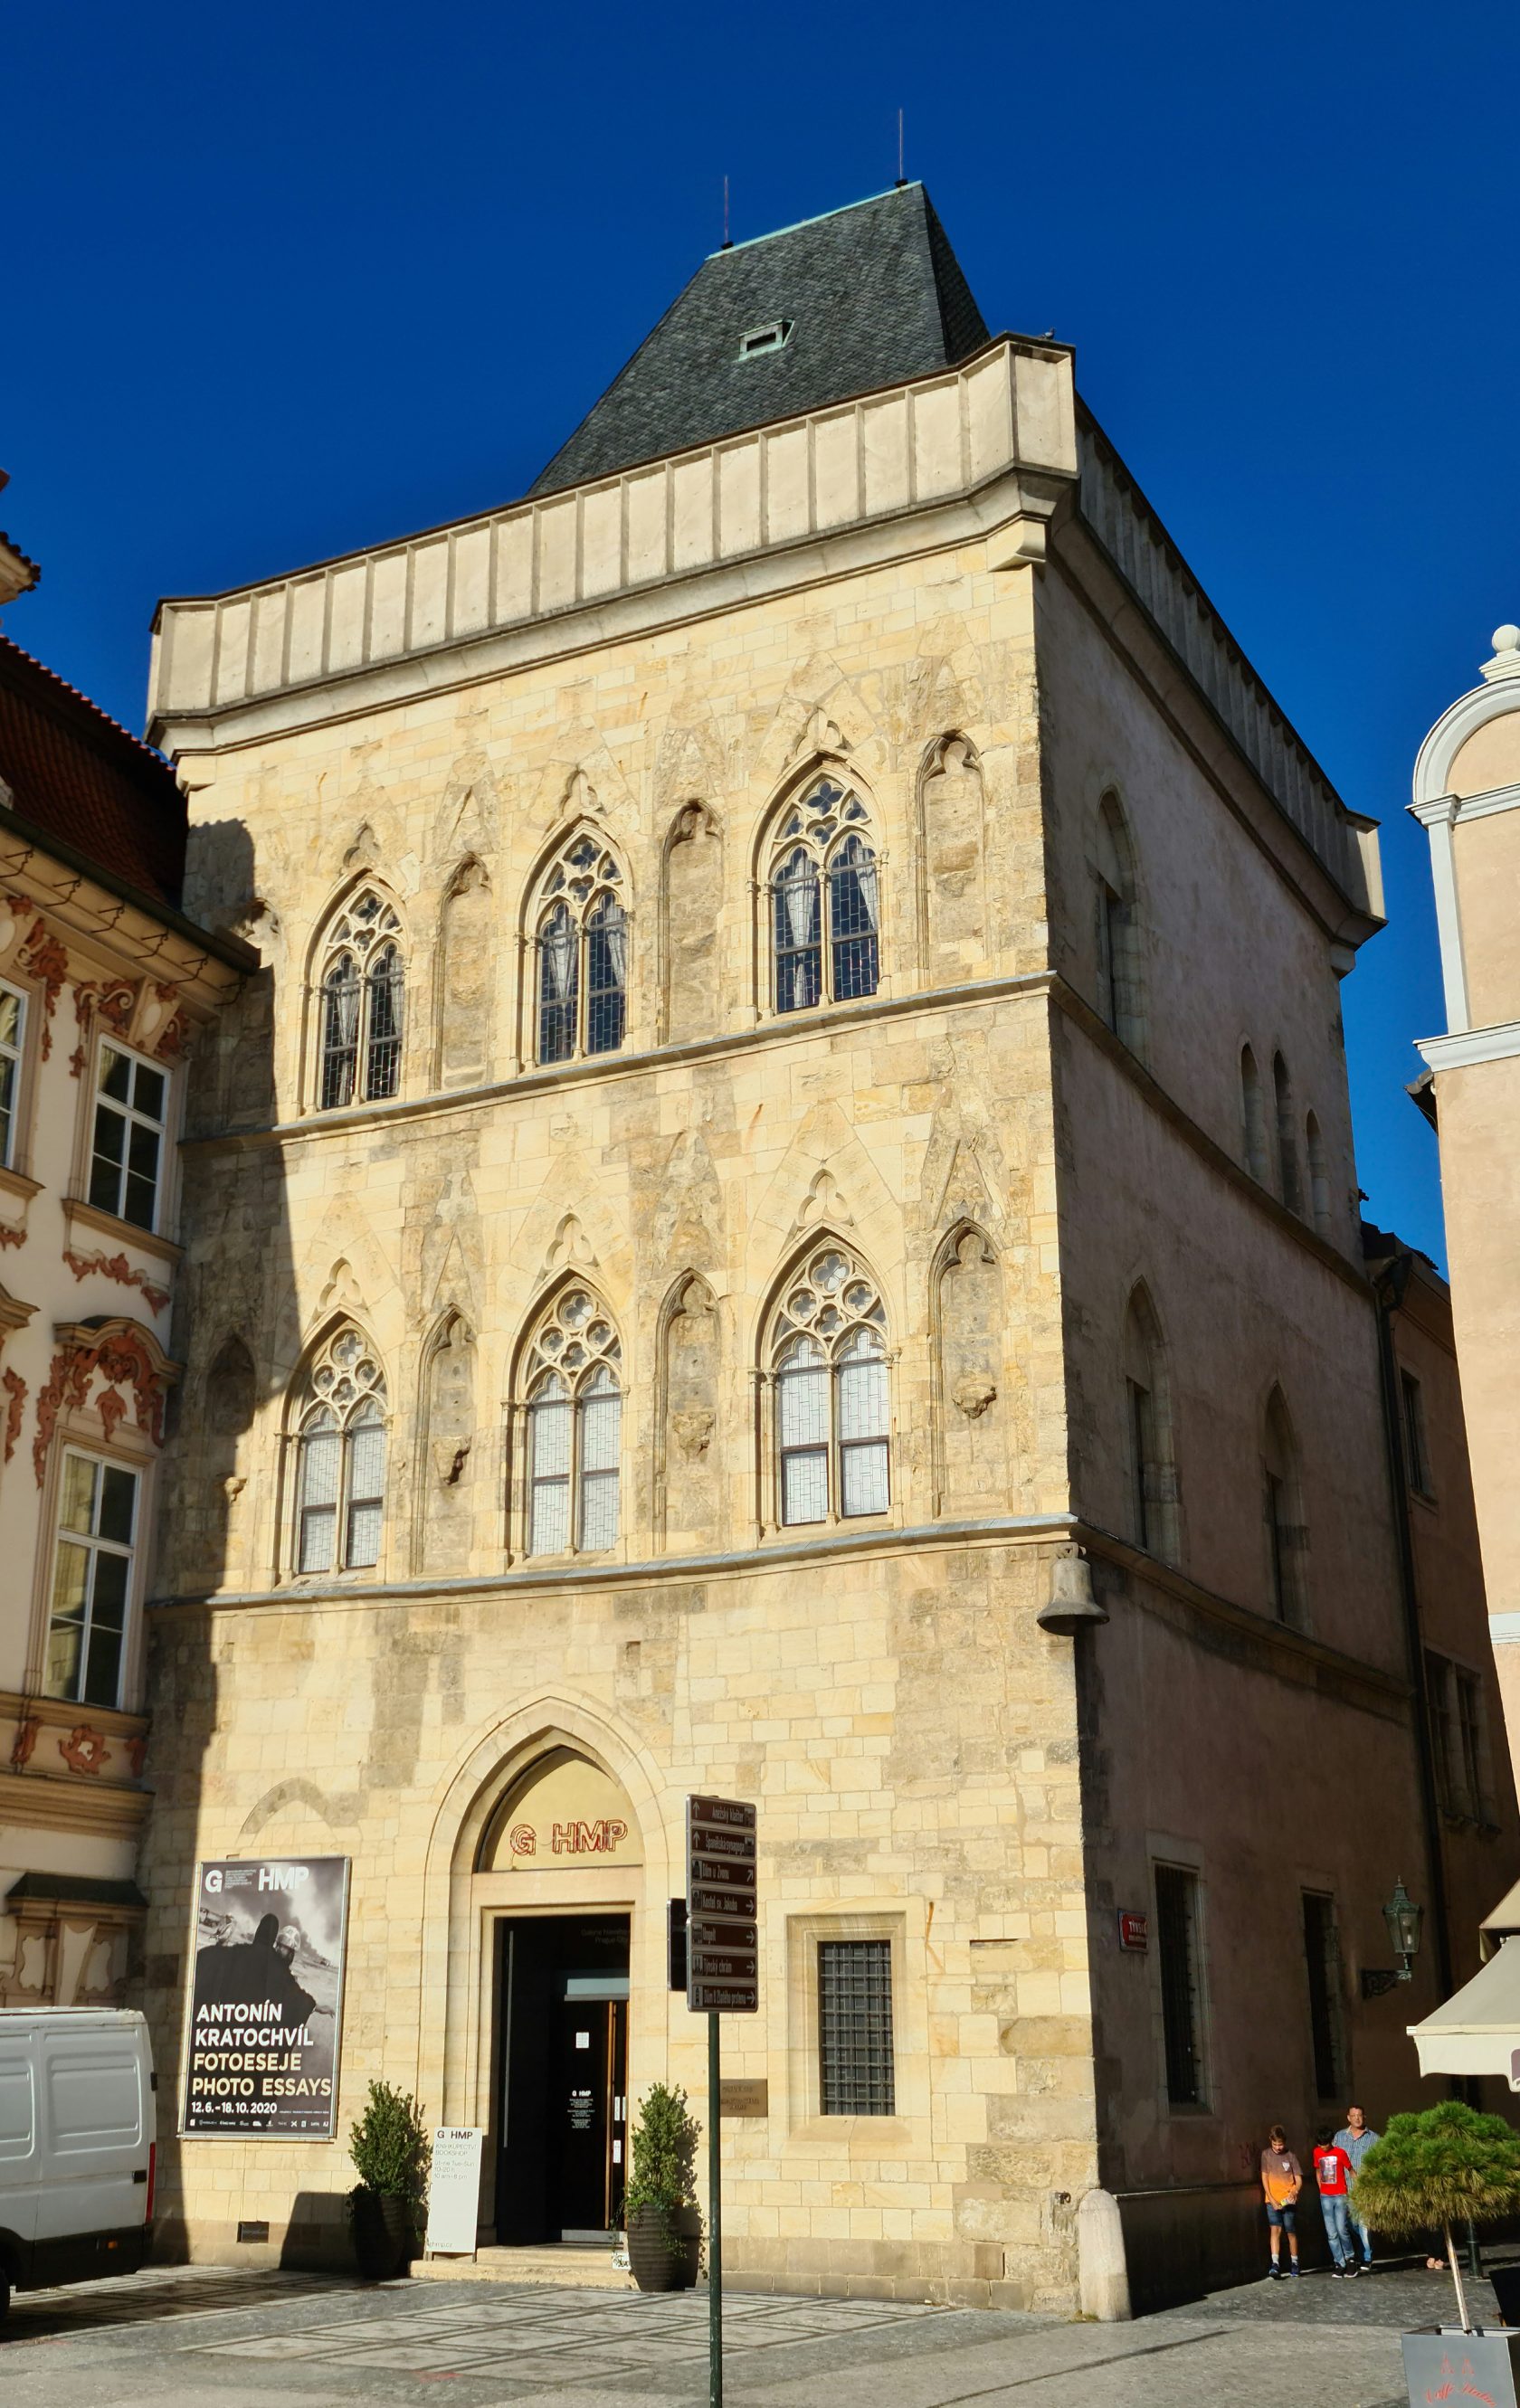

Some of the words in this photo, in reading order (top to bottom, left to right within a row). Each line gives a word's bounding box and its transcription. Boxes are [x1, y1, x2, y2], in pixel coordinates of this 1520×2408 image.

[510, 1824, 537, 1855] G
[552, 1819, 628, 1854] HMP
[204, 1870, 223, 1893] G
[258, 1866, 309, 1891] HMP
[196, 1999, 282, 2023] ANTONÍN
[195, 2024, 313, 2047] KRATOCHVÍL
[194, 2052, 301, 2071] FOTOESEJE
[192, 2078, 254, 2096] PHOTO
[261, 2078, 332, 2096] ESSAYS
[437, 2130, 445, 2138] G
[451, 2130, 473, 2139] HMP
